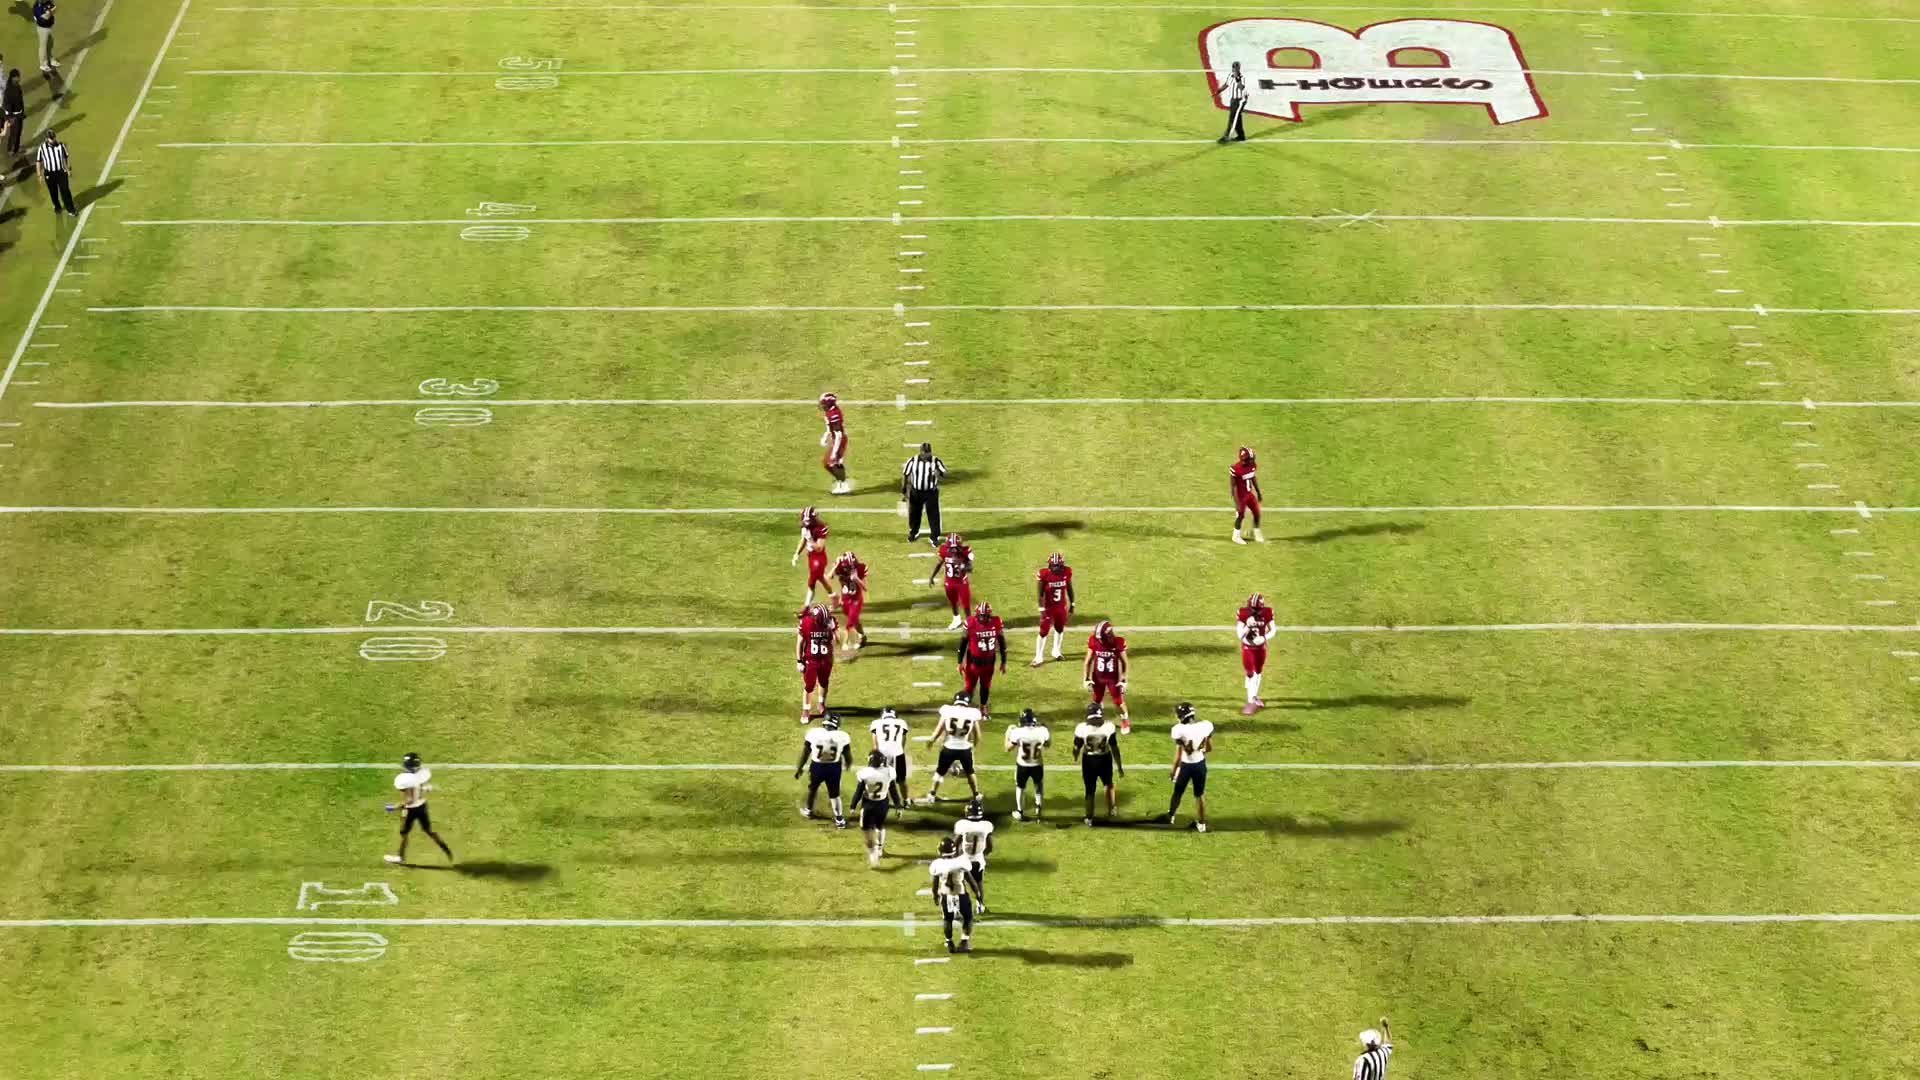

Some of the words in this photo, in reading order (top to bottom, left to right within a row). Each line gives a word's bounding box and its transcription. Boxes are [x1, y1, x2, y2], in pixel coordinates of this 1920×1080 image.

[496, 56, 563, 91] 50
[1198, 17, 1550, 126] B
[459, 201, 536, 242] 40
[413, 377, 500, 427] 30
[1048, 580, 1067, 588] TIGERS
[1053, 589, 1062, 602] 3
[358, 599, 456, 662] 20
[977, 638, 996, 651] 42
[882, 724, 901, 742] 57
[949, 719, 971, 736] 55
[1022, 743, 1041, 761] 56
[286, 881, 400, 964] 10
